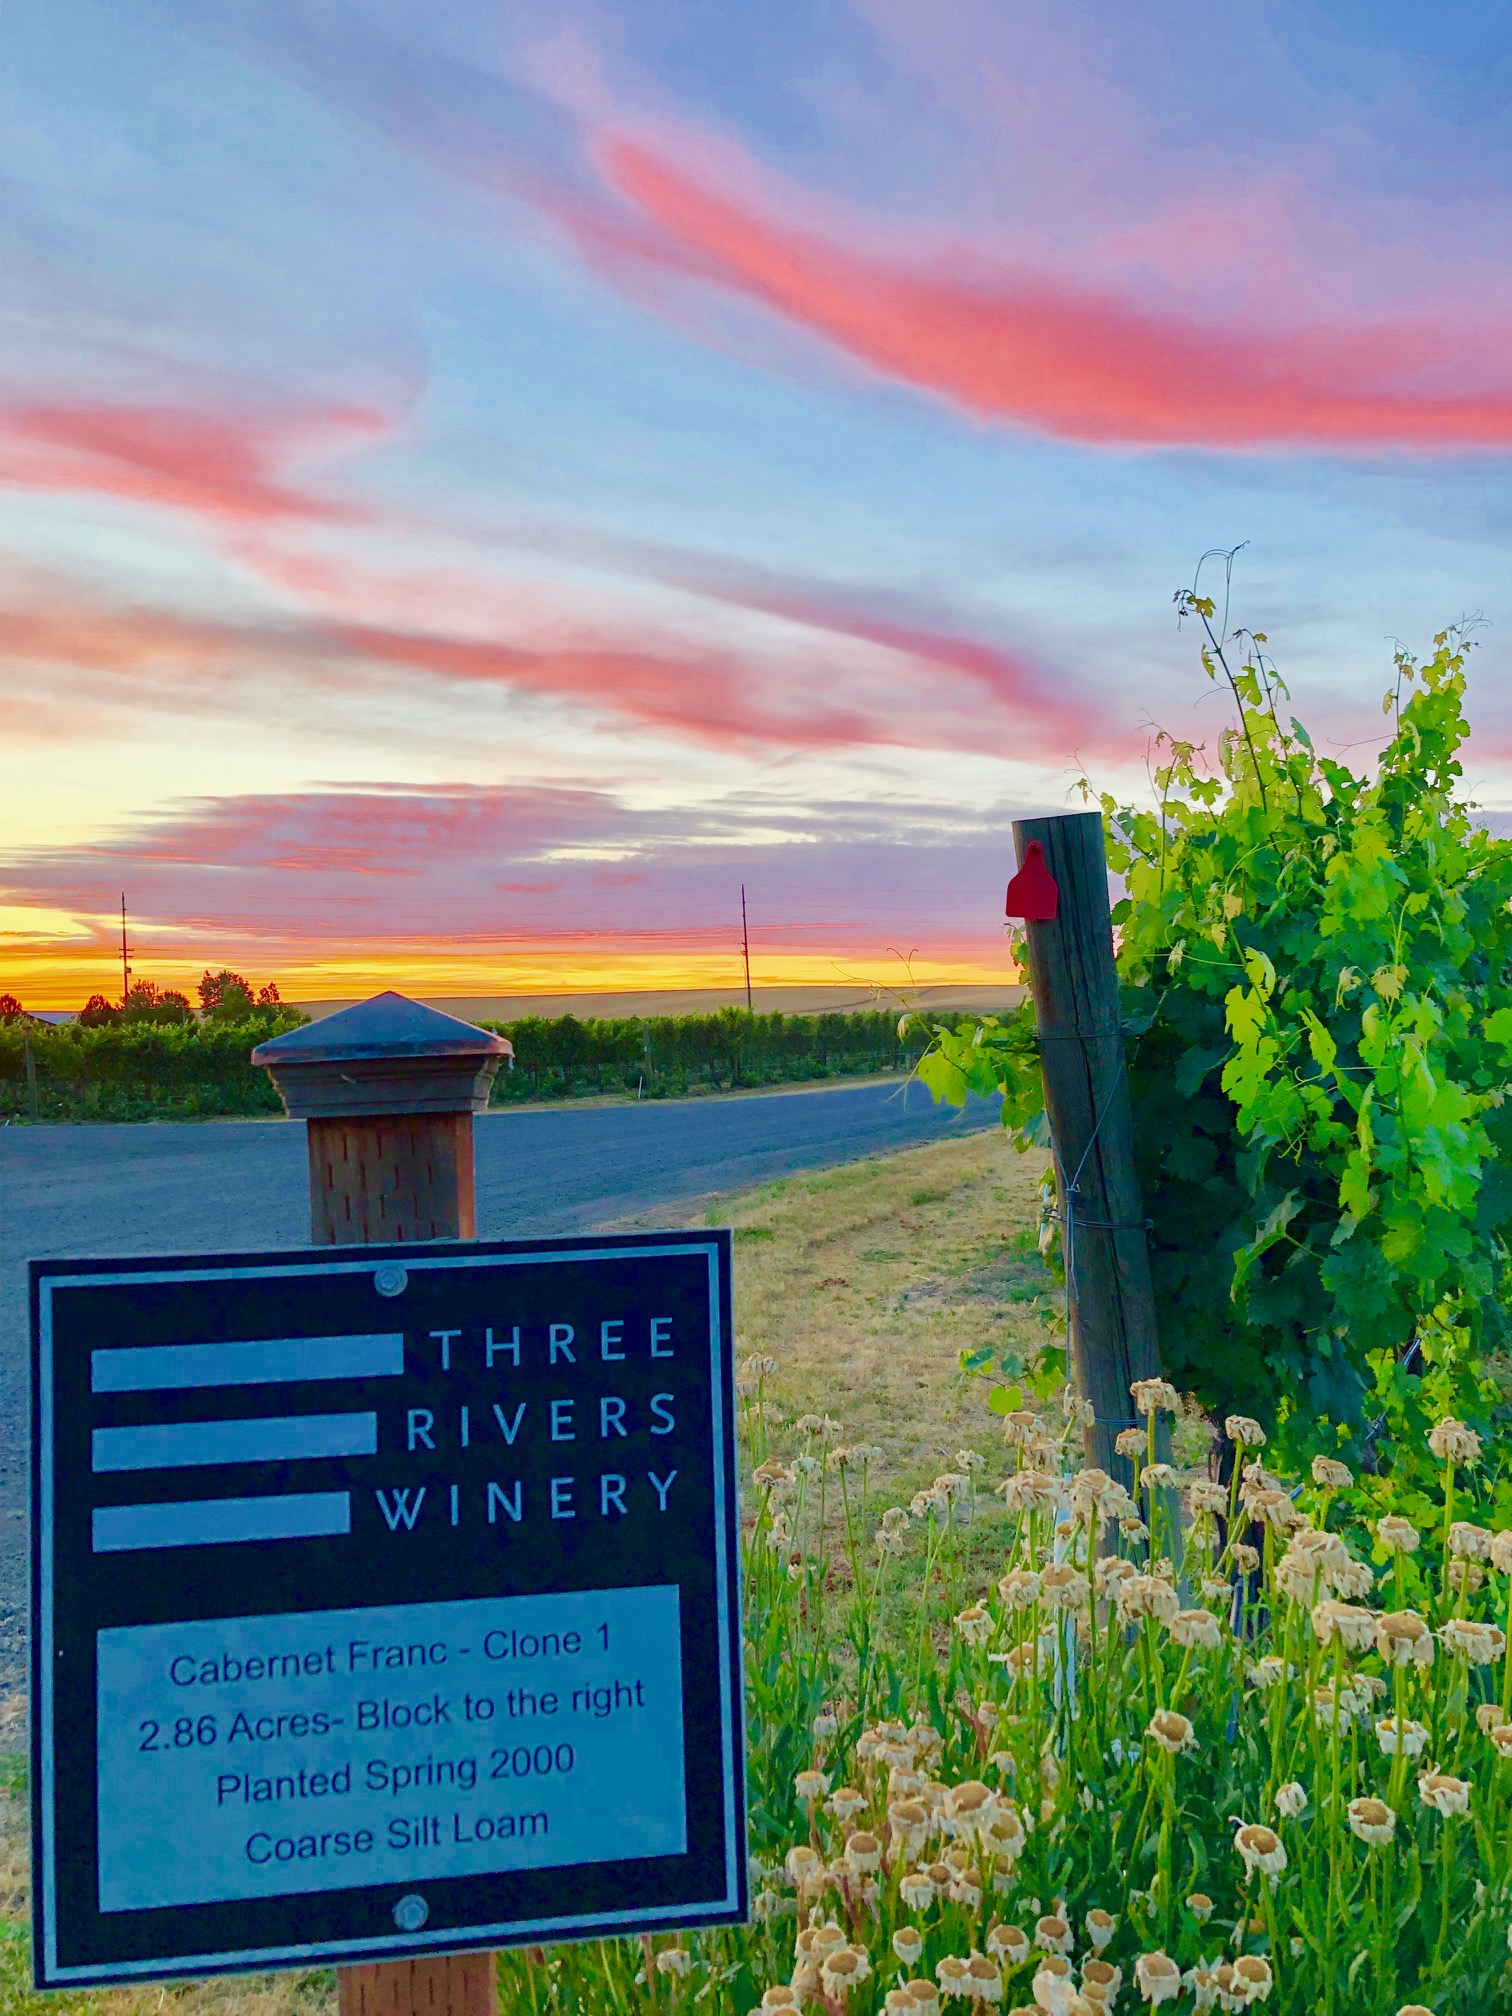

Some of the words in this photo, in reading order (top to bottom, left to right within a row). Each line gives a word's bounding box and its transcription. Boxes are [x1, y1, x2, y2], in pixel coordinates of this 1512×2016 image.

[429, 1317, 674, 1371] THREE
[407, 1393, 676, 1450] RIVERS
[375, 1469, 678, 1531] WINERY
[170, 1644, 335, 1688] Cabernet
[349, 1636, 448, 1672] Franc
[483, 1628, 582, 1661] Clone
[597, 1622, 610, 1650] 1
[138, 1715, 217, 1752] 2.86
[356, 1694, 452, 1732] Block
[464, 1692, 496, 1721] to
[507, 1686, 559, 1717] the
[572, 1679, 645, 1718] right
[216, 1765, 352, 1805] Planted
[366, 1751, 477, 1796] Spring
[490, 1743, 576, 1780] 2000
[245, 1826, 374, 1865] Coarse
[387, 1815, 441, 1850] Silt
[454, 1811, 549, 1845] Loam
